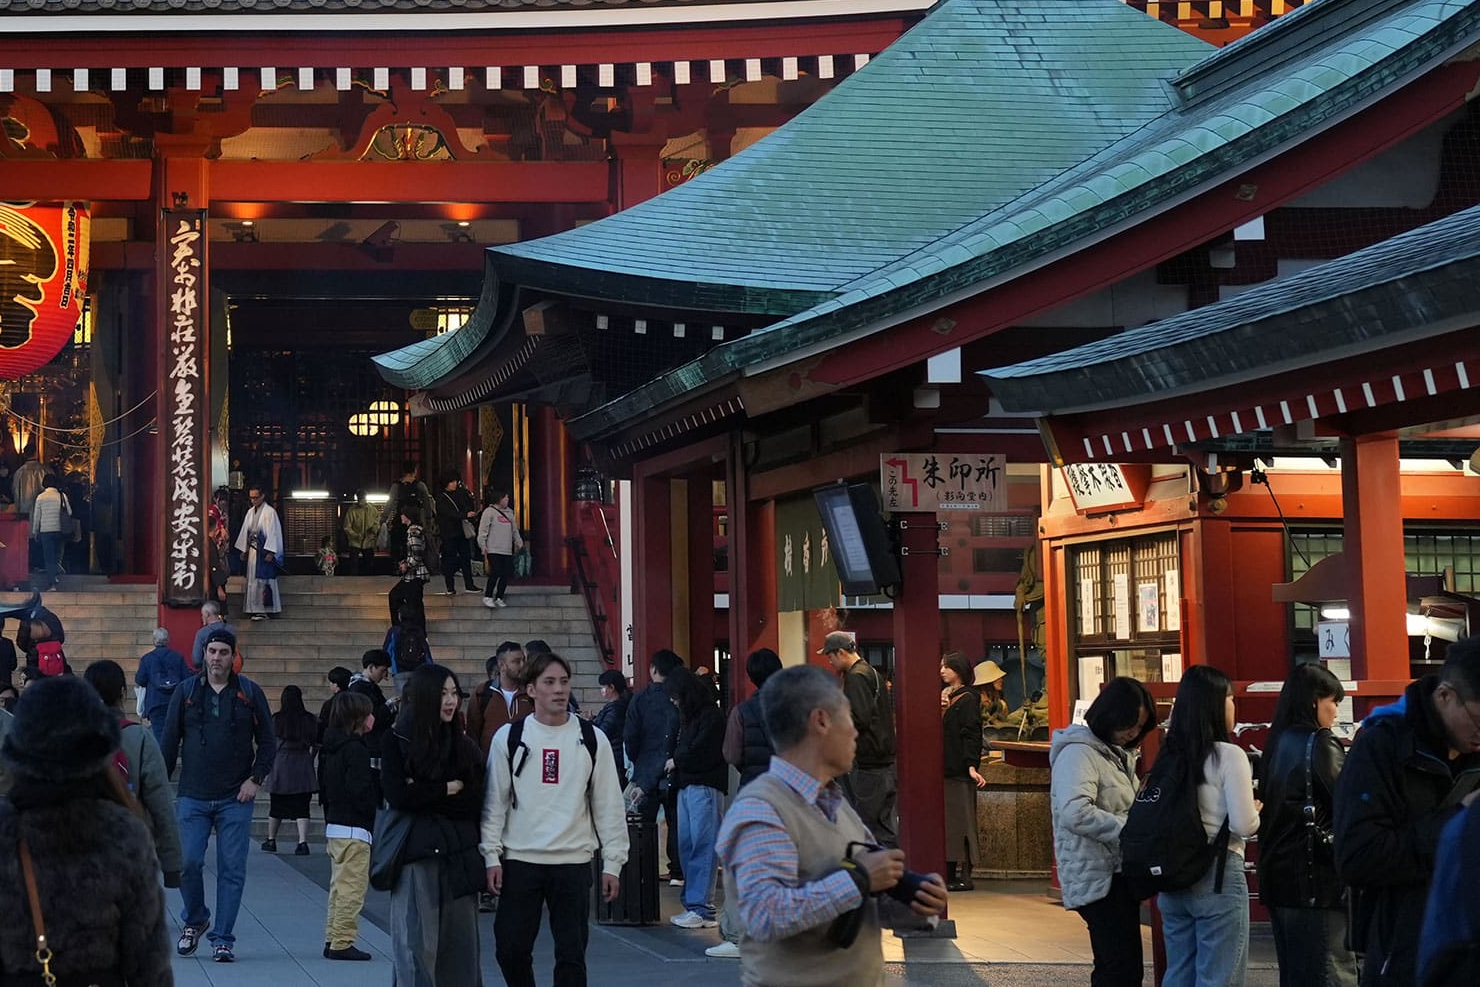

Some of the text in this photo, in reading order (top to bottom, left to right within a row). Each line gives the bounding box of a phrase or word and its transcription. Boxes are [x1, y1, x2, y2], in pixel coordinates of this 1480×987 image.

[887, 470, 899, 508] この先左
[922, 455, 1000, 491] 朱印所
